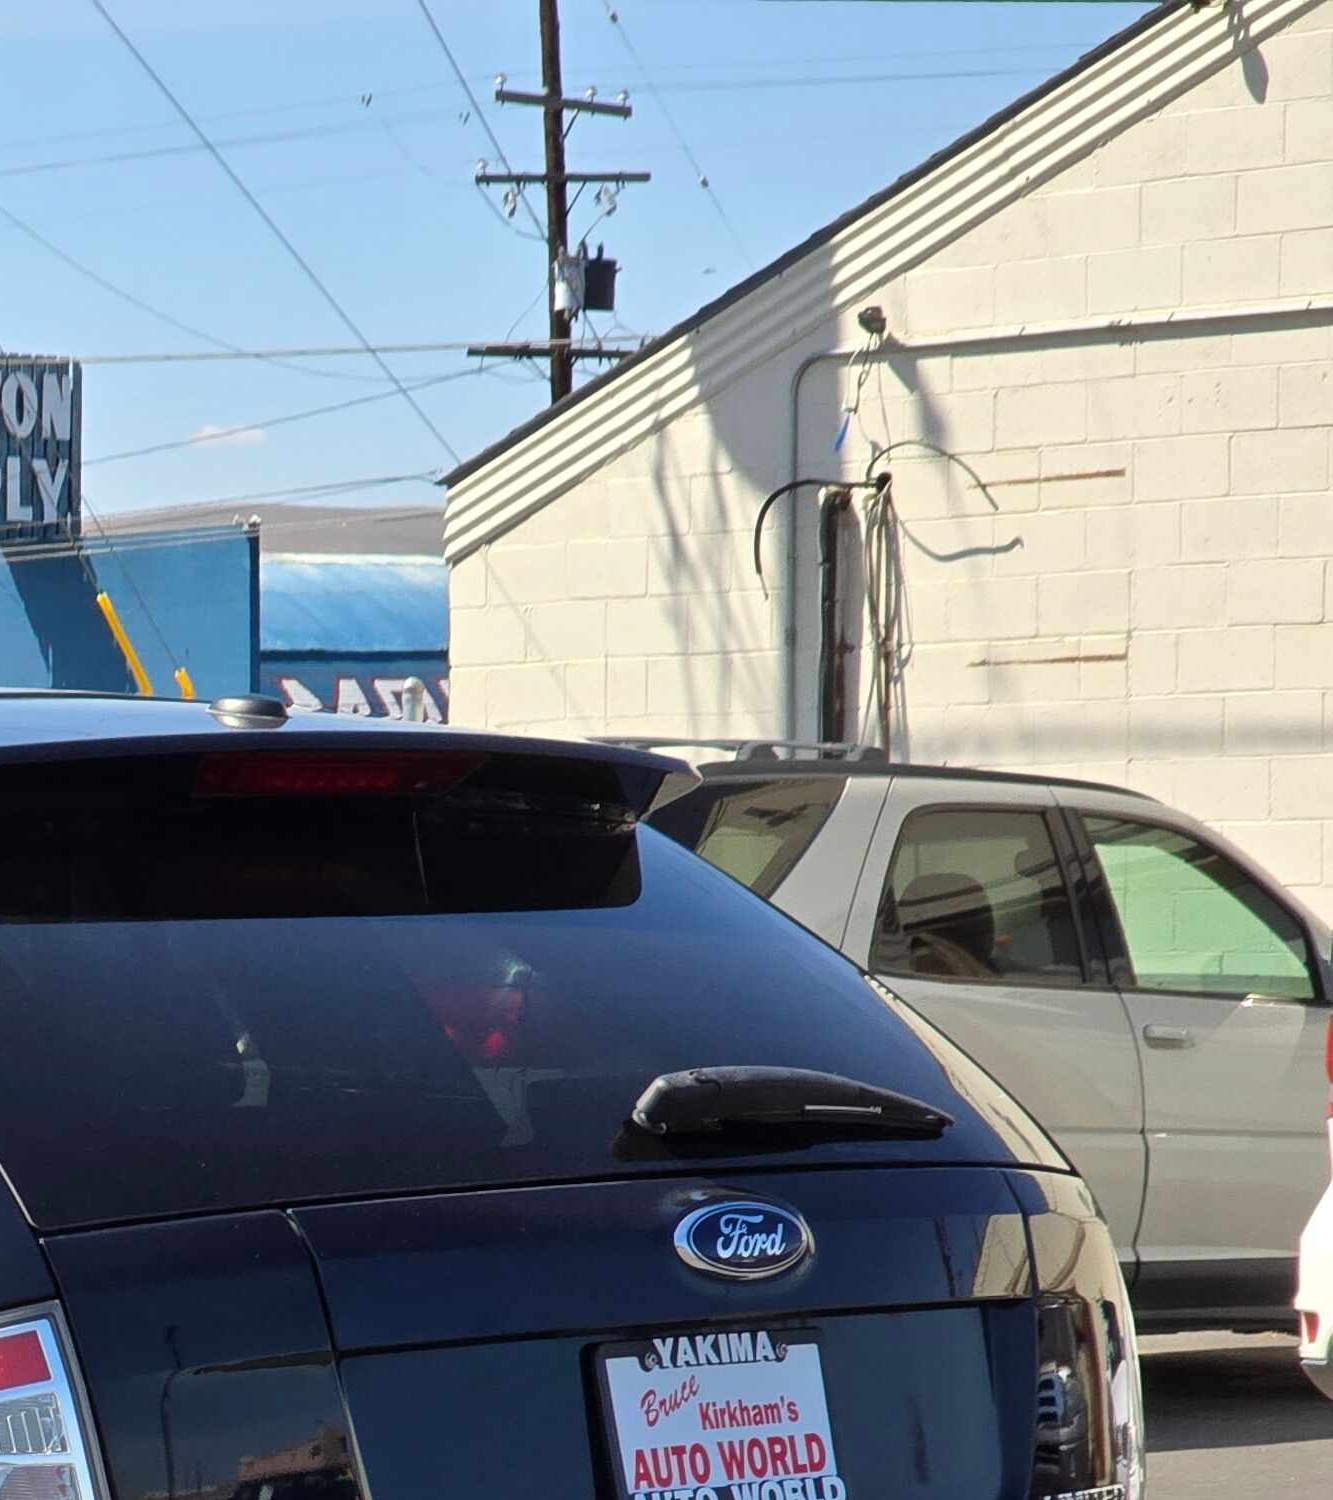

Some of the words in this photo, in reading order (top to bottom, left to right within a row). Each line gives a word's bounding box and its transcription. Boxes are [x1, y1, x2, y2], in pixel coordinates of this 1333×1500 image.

[716, 1213, 786, 1259] Ford
[652, 1331, 777, 1367] YAKIMA
[640, 1374, 700, 1428] Bruce
[698, 1395, 800, 1431] Kirkham's
[634, 1442, 711, 1490] AUTO
[716, 1432, 827, 1481] WORLD
